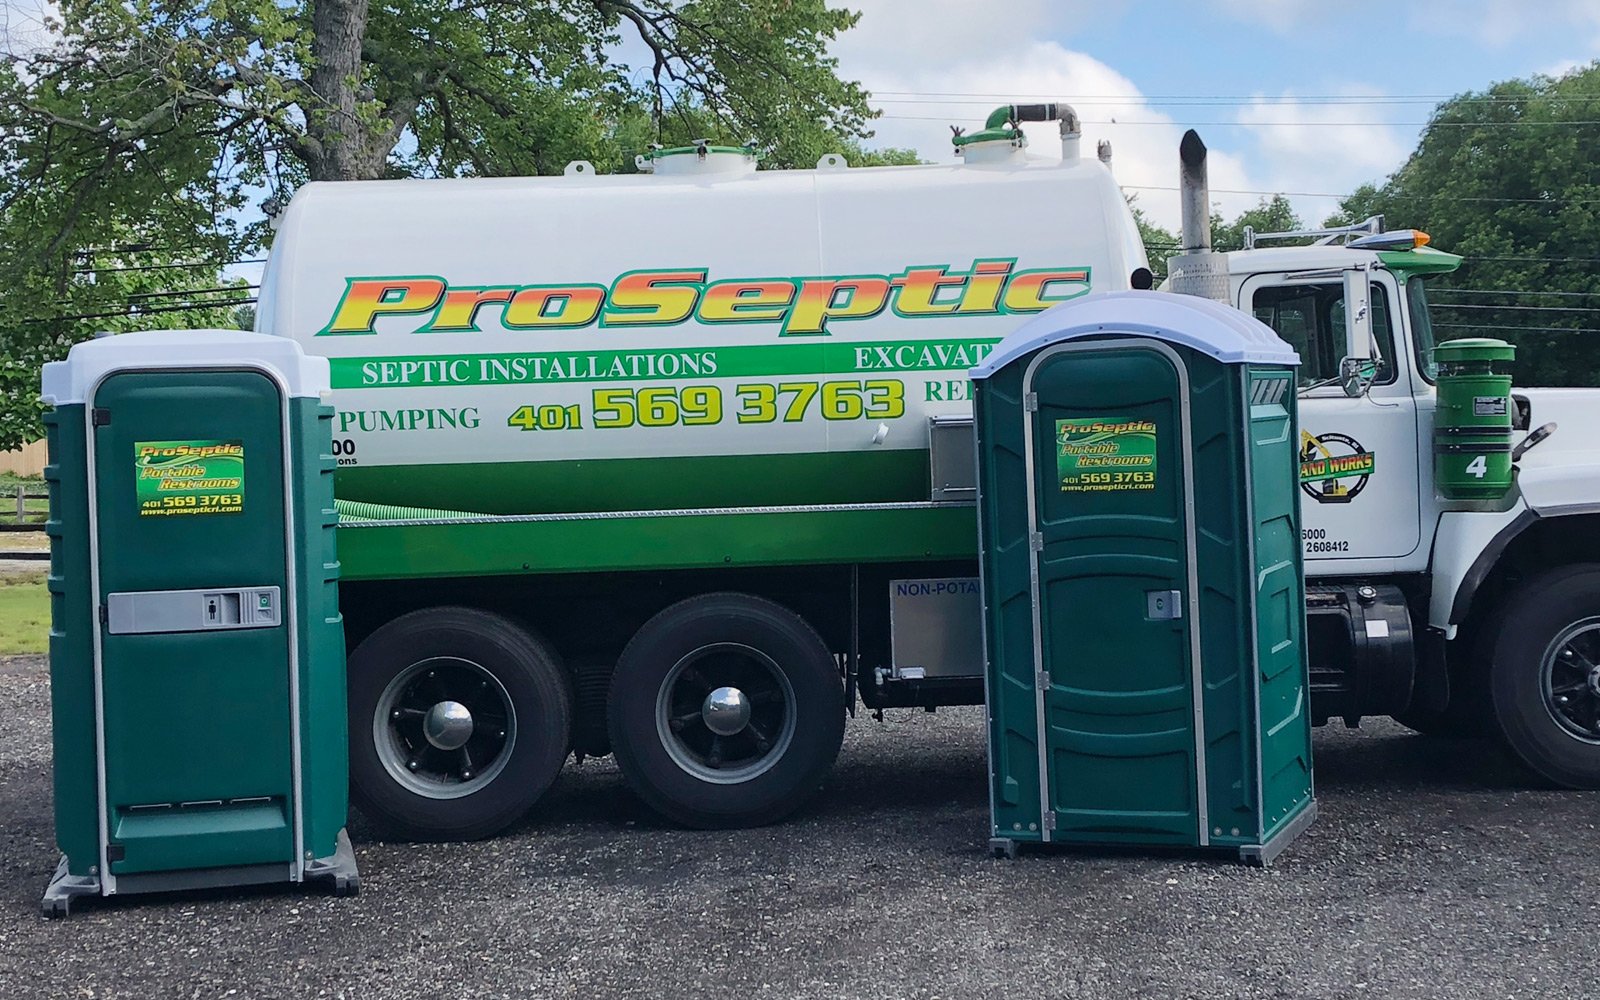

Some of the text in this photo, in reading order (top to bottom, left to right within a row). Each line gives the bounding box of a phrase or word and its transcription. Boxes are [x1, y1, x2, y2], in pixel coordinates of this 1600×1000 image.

[315, 257, 1092, 337] ProSeptic
[854, 343, 992, 369] EXCAVAT
[362, 352, 718, 385] SEPTIC INSTALLATIONS
[507, 378, 905, 431] 401 569 3763
[338, 407, 481, 432] PUMPING
[1060, 421, 1153, 434] ProSeptic
[140, 444, 241, 457] ProSeptic
[332, 439, 356, 455] 00
[1061, 442, 1118, 456] Portable
[1076, 455, 1153, 467] Restrooms
[1330, 454, 1372, 473] WORKS
[1465, 456, 1487, 478] 4
[141, 464, 206, 479] Portable
[1081, 473, 1110, 484] 569
[1114, 472, 1154, 483] 3763
[159, 477, 241, 491] Restrooms
[1061, 483, 1155, 492] www.prosepticri.com
[163, 496, 196, 507] 569
[200, 494, 242, 506] 3763
[141, 506, 242, 516] www.prosepticri.com
[1306, 541, 1349, 552] 2608412
[897, 582, 980, 596] NON-POTA
